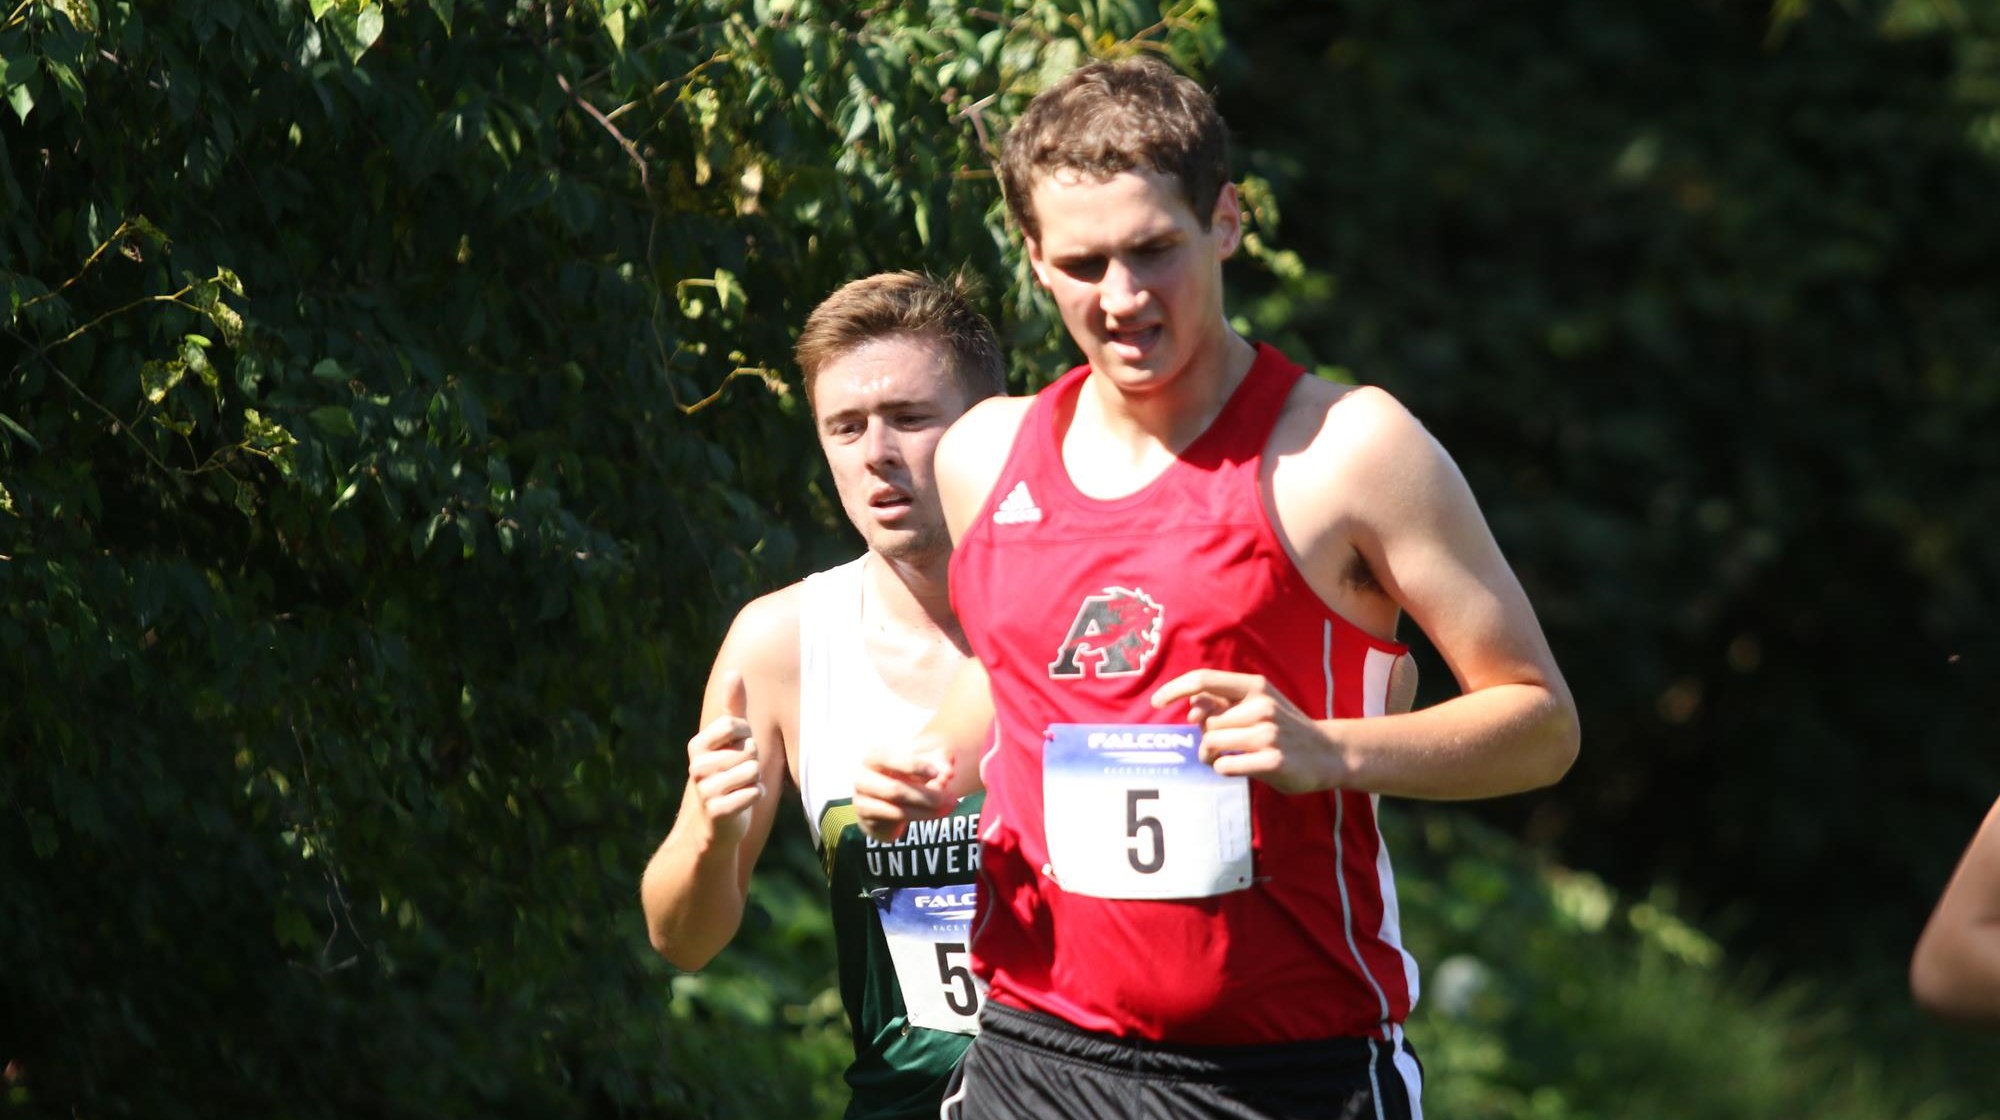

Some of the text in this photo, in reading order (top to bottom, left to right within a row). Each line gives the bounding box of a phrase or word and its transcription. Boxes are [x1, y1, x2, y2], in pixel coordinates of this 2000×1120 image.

[1087, 732, 1195, 749] FALCON
[866, 813, 981, 849] AWARE
[1126, 789, 1165, 875] 5
[934, 942, 979, 1017] 5
